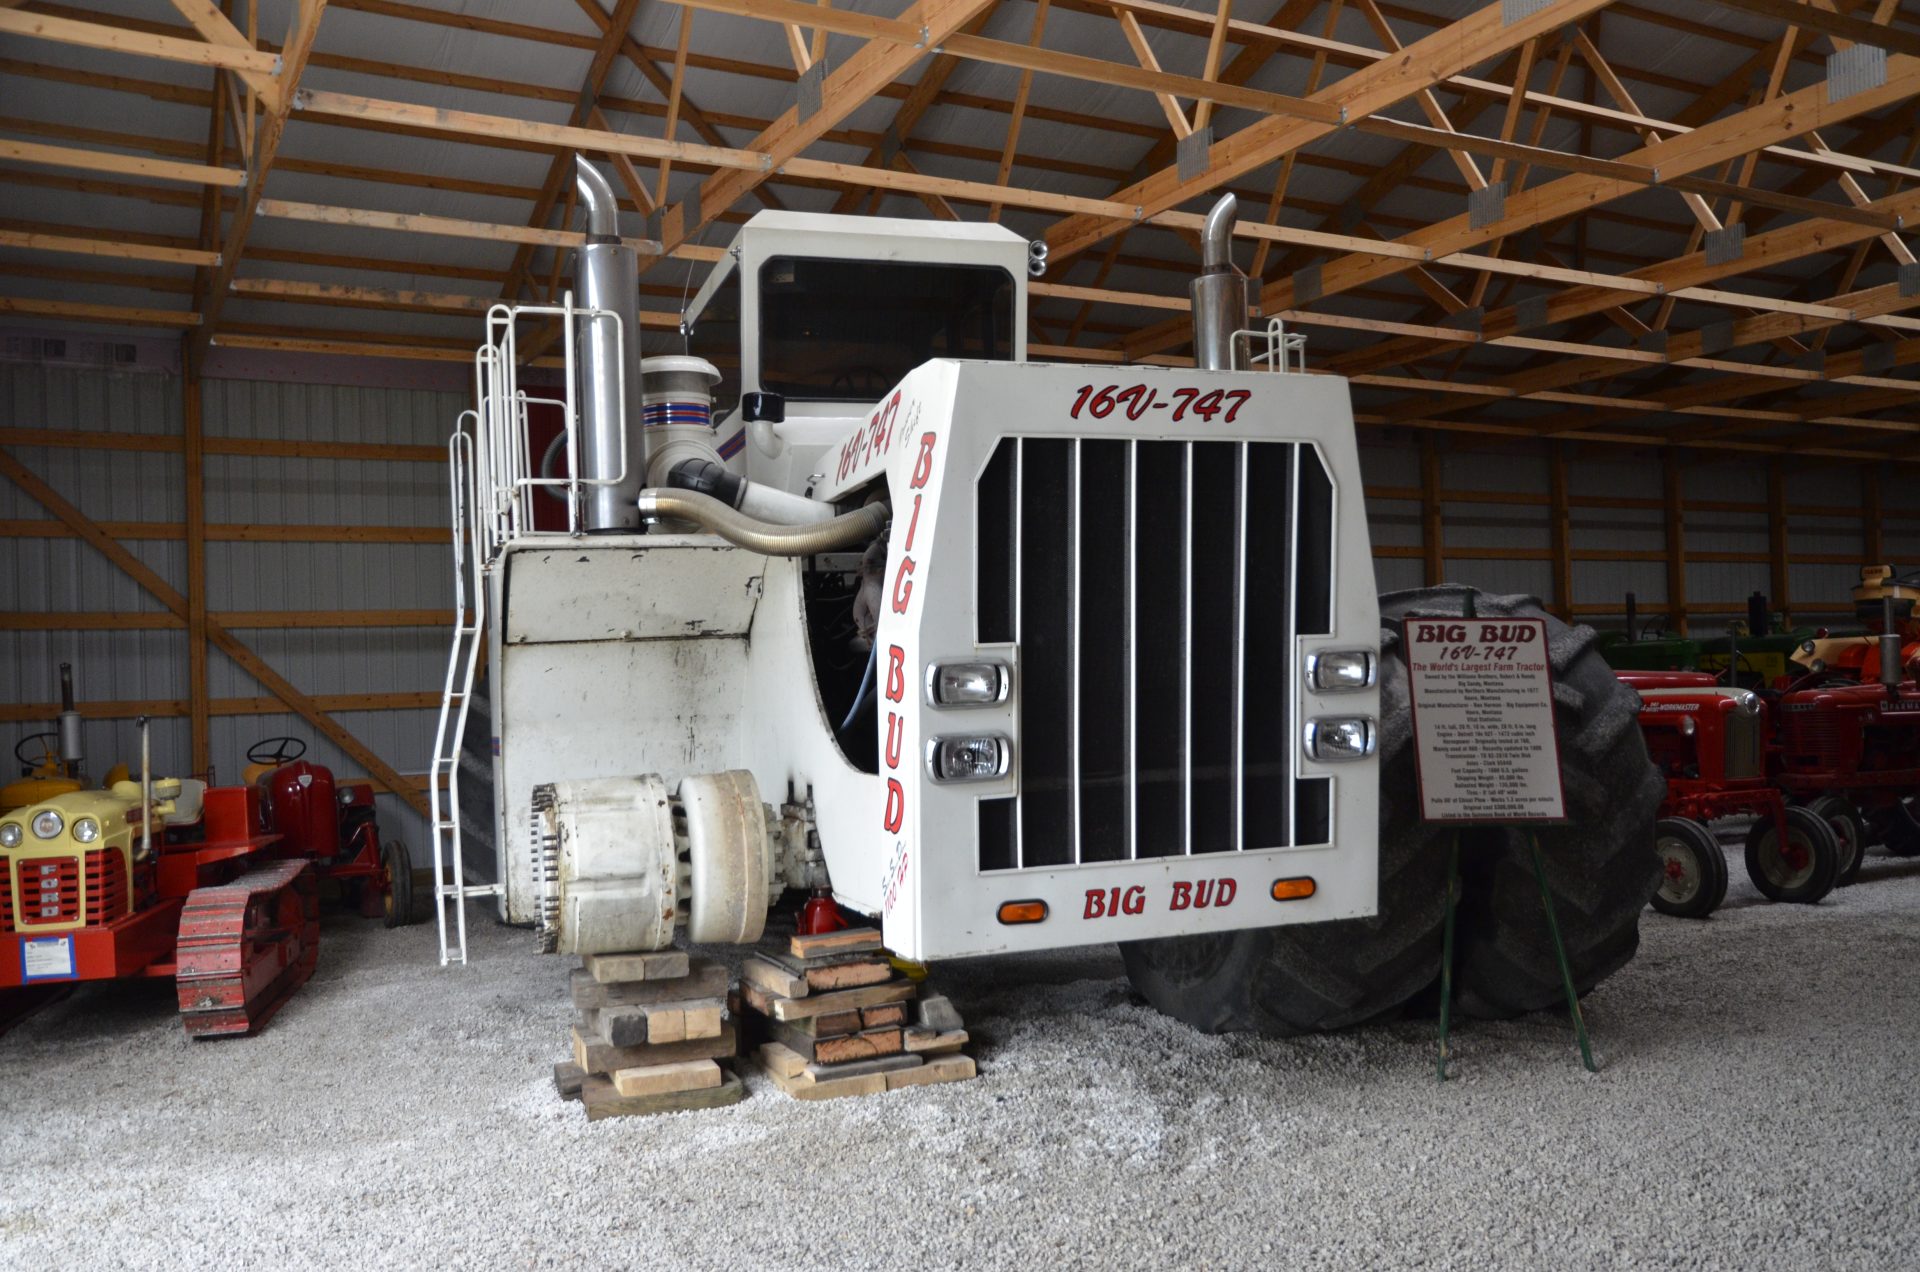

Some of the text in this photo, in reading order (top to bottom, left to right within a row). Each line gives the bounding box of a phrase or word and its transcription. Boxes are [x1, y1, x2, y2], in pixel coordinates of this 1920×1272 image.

[1070, 384, 1251, 423] 16V-747
[884, 432, 936, 834] BIG BUD
[1416, 624, 1536, 643] BIG BUD
[1440, 645, 1518, 660] 16V-747
[1413, 662, 1544, 673] The World's Largest Farm Tractor
[1083, 878, 1237, 920] BIG BUD
